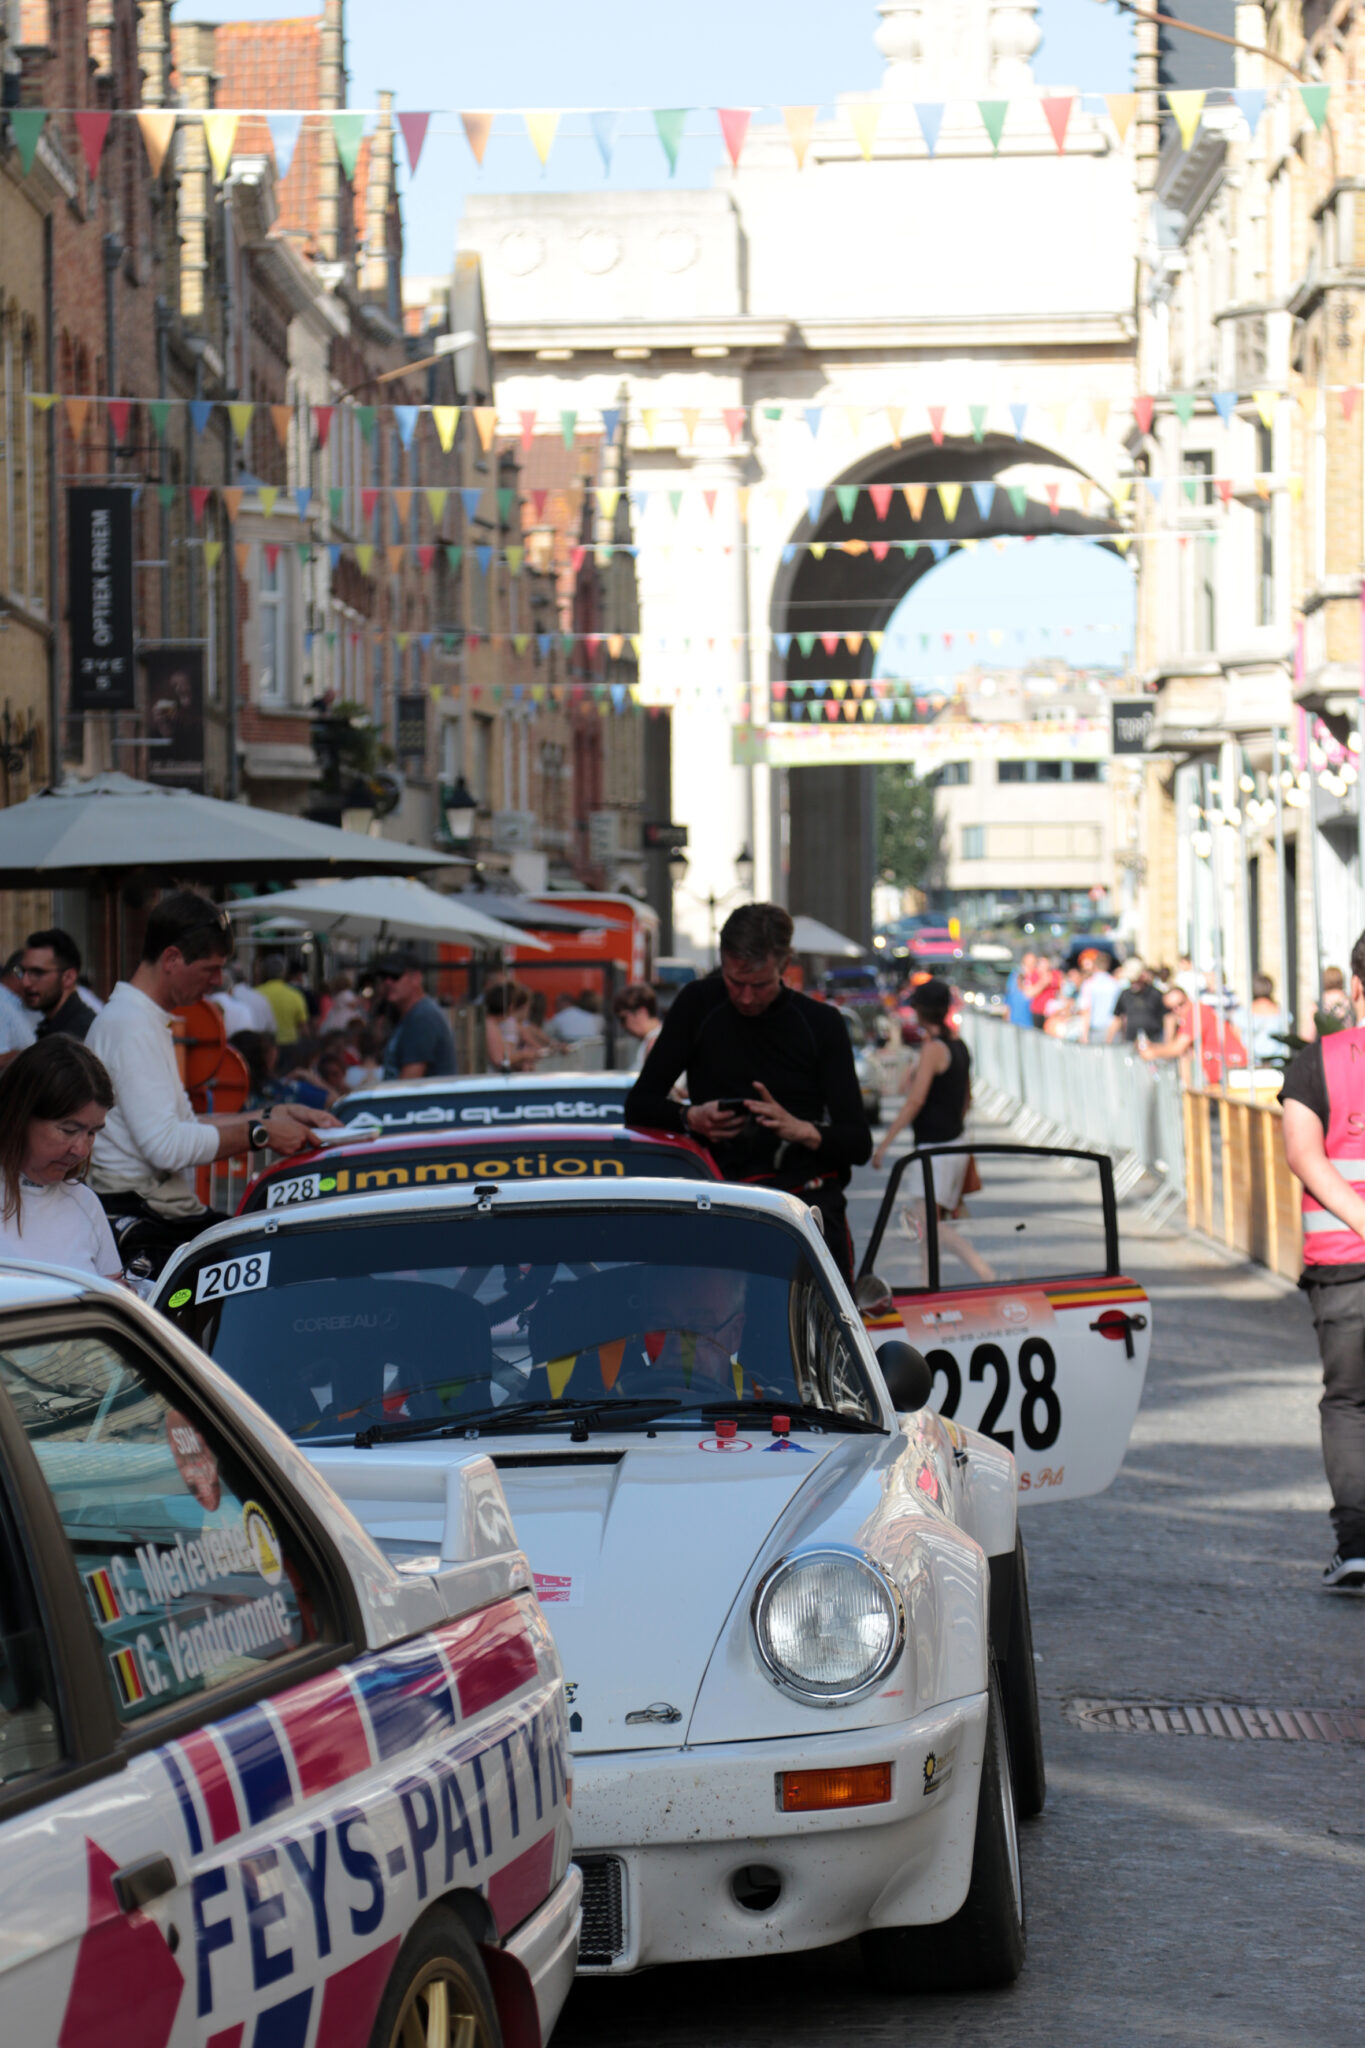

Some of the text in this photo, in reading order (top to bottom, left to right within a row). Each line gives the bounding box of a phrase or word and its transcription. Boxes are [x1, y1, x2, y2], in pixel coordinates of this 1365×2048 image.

[90, 508, 113, 647] OPTIEK PRIEM
[345, 1100, 626, 1129] Audi quattr
[272, 1178, 314, 1208] 228
[336, 1153, 624, 1192] Immotion
[202, 1257, 262, 1299] 208
[292, 1312, 378, 1334] CORBEAU
[924, 1336, 1061, 1454] 228
[111, 1555, 146, 1616] C.
[136, 1591, 292, 1696] G. Vandromme
